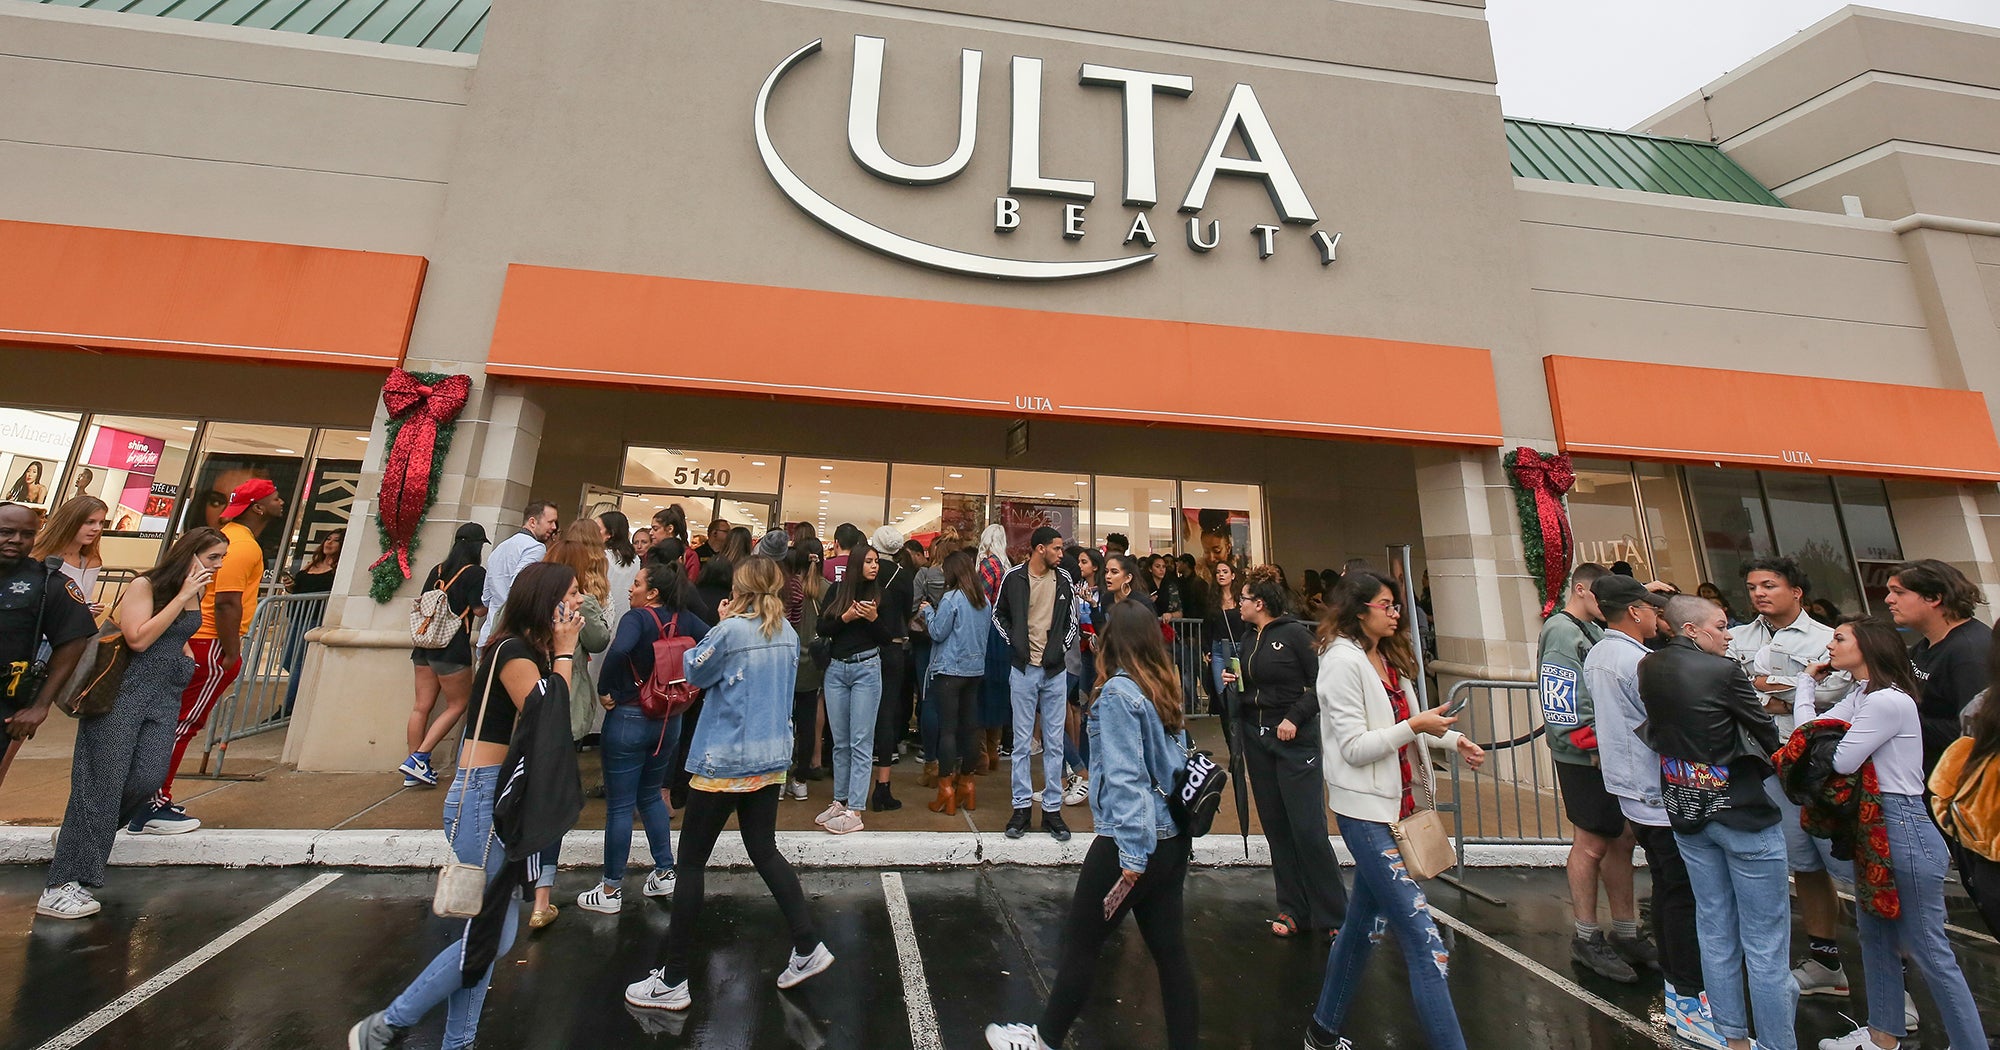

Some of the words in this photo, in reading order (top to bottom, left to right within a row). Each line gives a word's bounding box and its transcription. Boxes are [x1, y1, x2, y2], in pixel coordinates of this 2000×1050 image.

[847, 34, 1318, 225] ULTA
[994, 197, 1342, 265] BEAUTY
[1016, 395, 1053, 411] ULTA
[128, 440, 149, 452] shine
[1782, 450, 1813, 464] ULTA
[673, 467, 731, 487] 5140
[303, 471, 361, 558] KYL
[1011, 508, 1063, 527] NAKED
[1579, 540, 1644, 564] ULTA
[1181, 752, 1216, 801] adid
